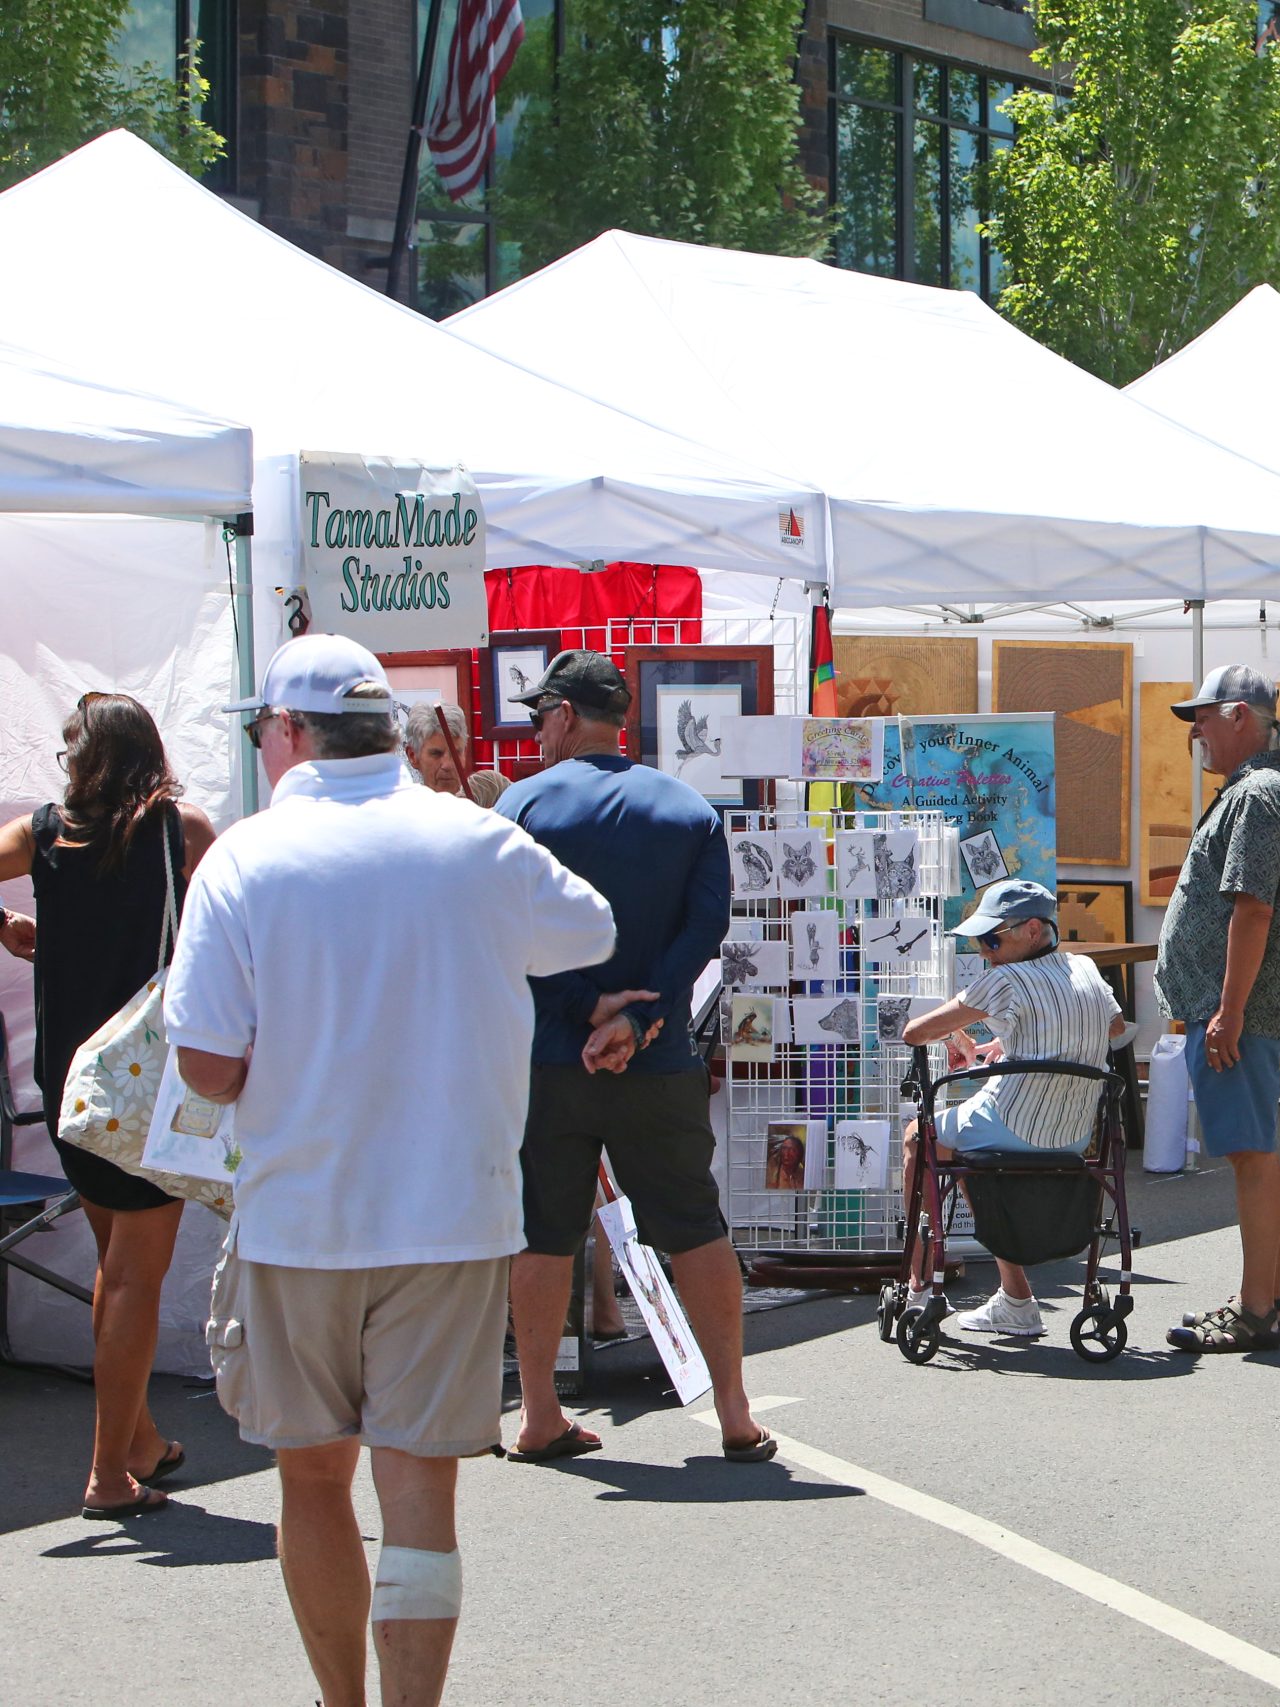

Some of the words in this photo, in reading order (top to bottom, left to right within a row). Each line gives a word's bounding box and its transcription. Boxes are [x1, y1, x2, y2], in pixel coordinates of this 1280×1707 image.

[306, 491, 478, 549] TamaMade
[340, 555, 451, 612] Studios
[806, 727, 842, 742] Greeting
[844, 727, 869, 744] Cards
[919, 737, 953, 753] your
[958, 731, 1000, 753] Inner
[1002, 747, 1049, 793] Animal
[891, 773, 950, 789] Crative
[956, 770, 1013, 788] Palettes
[902, 796, 911, 806] A
[915, 795, 958, 807] Guided
[962, 793, 1008, 806] Activity
[967, 810, 998, 822] Book
